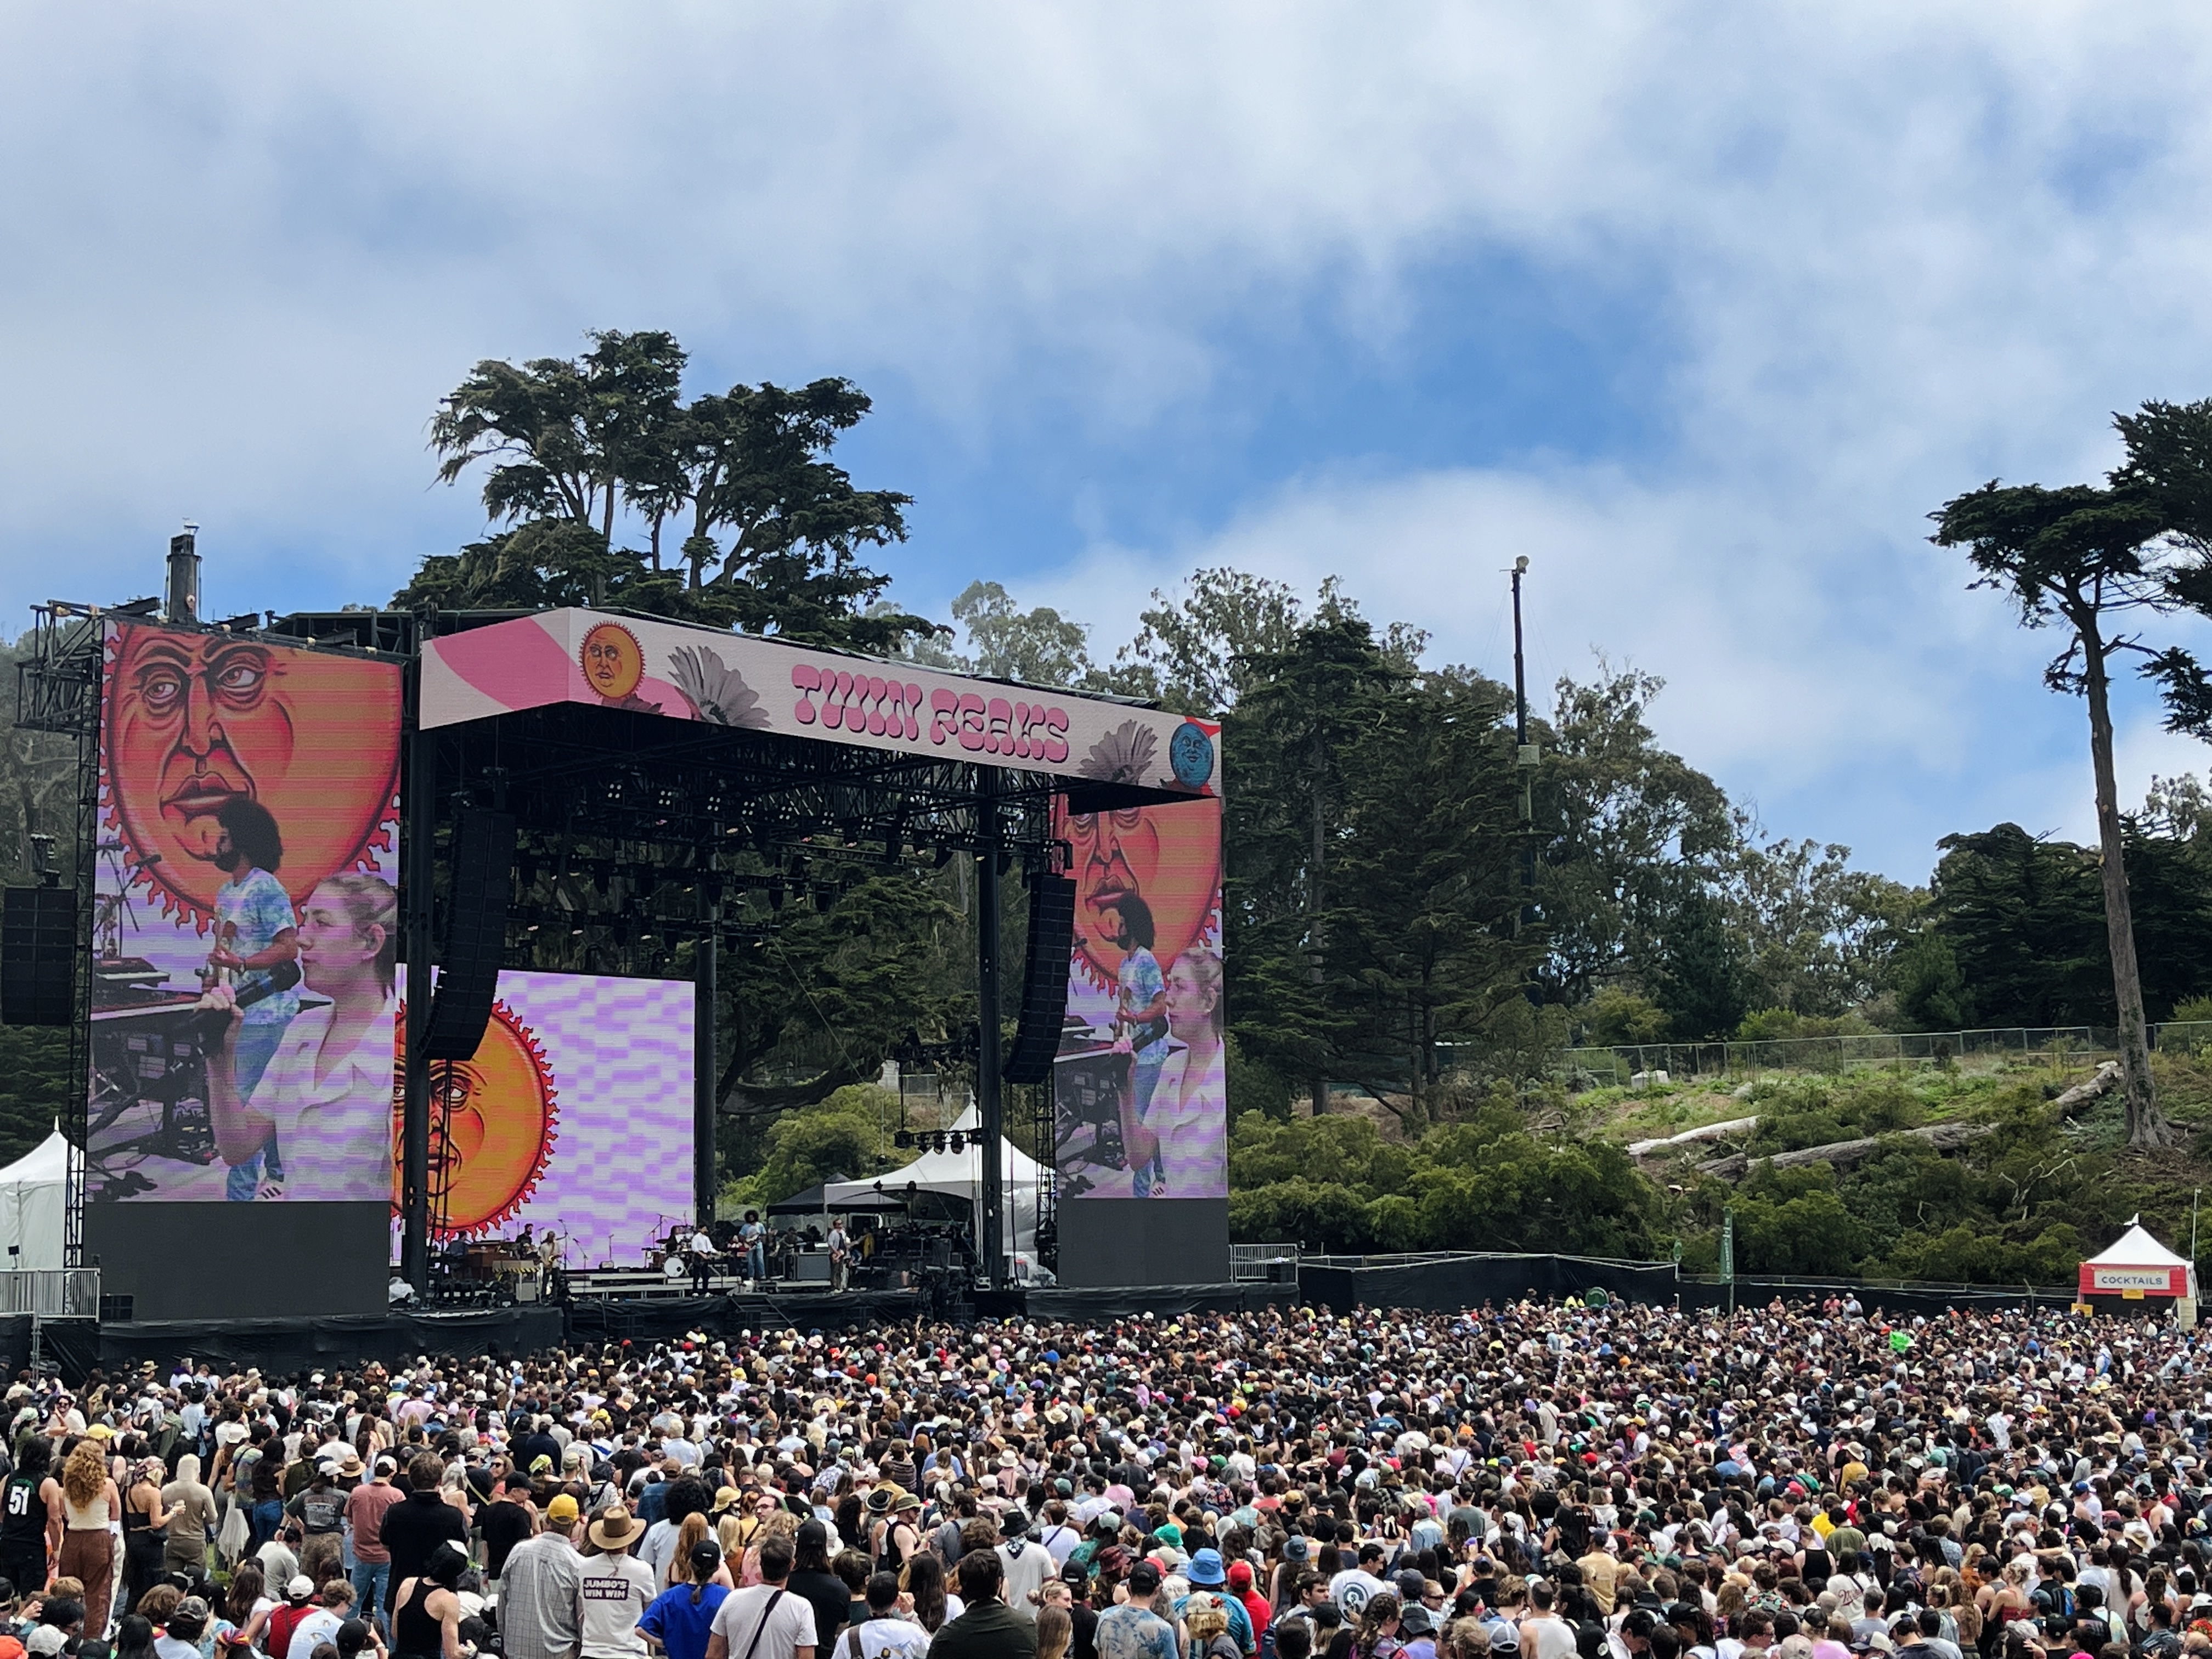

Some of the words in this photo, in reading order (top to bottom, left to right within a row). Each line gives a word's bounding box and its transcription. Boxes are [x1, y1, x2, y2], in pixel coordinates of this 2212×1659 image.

[792, 664, 923, 741] TWIN
[930, 689, 1069, 763] PEAKS
[2102, 1277, 2162, 1285] COCKTAILS
[8, 1486, 30, 1515] 51
[584, 1580, 627, 1589] JUMBO'S
[605, 1590, 625, 1598] WIN
